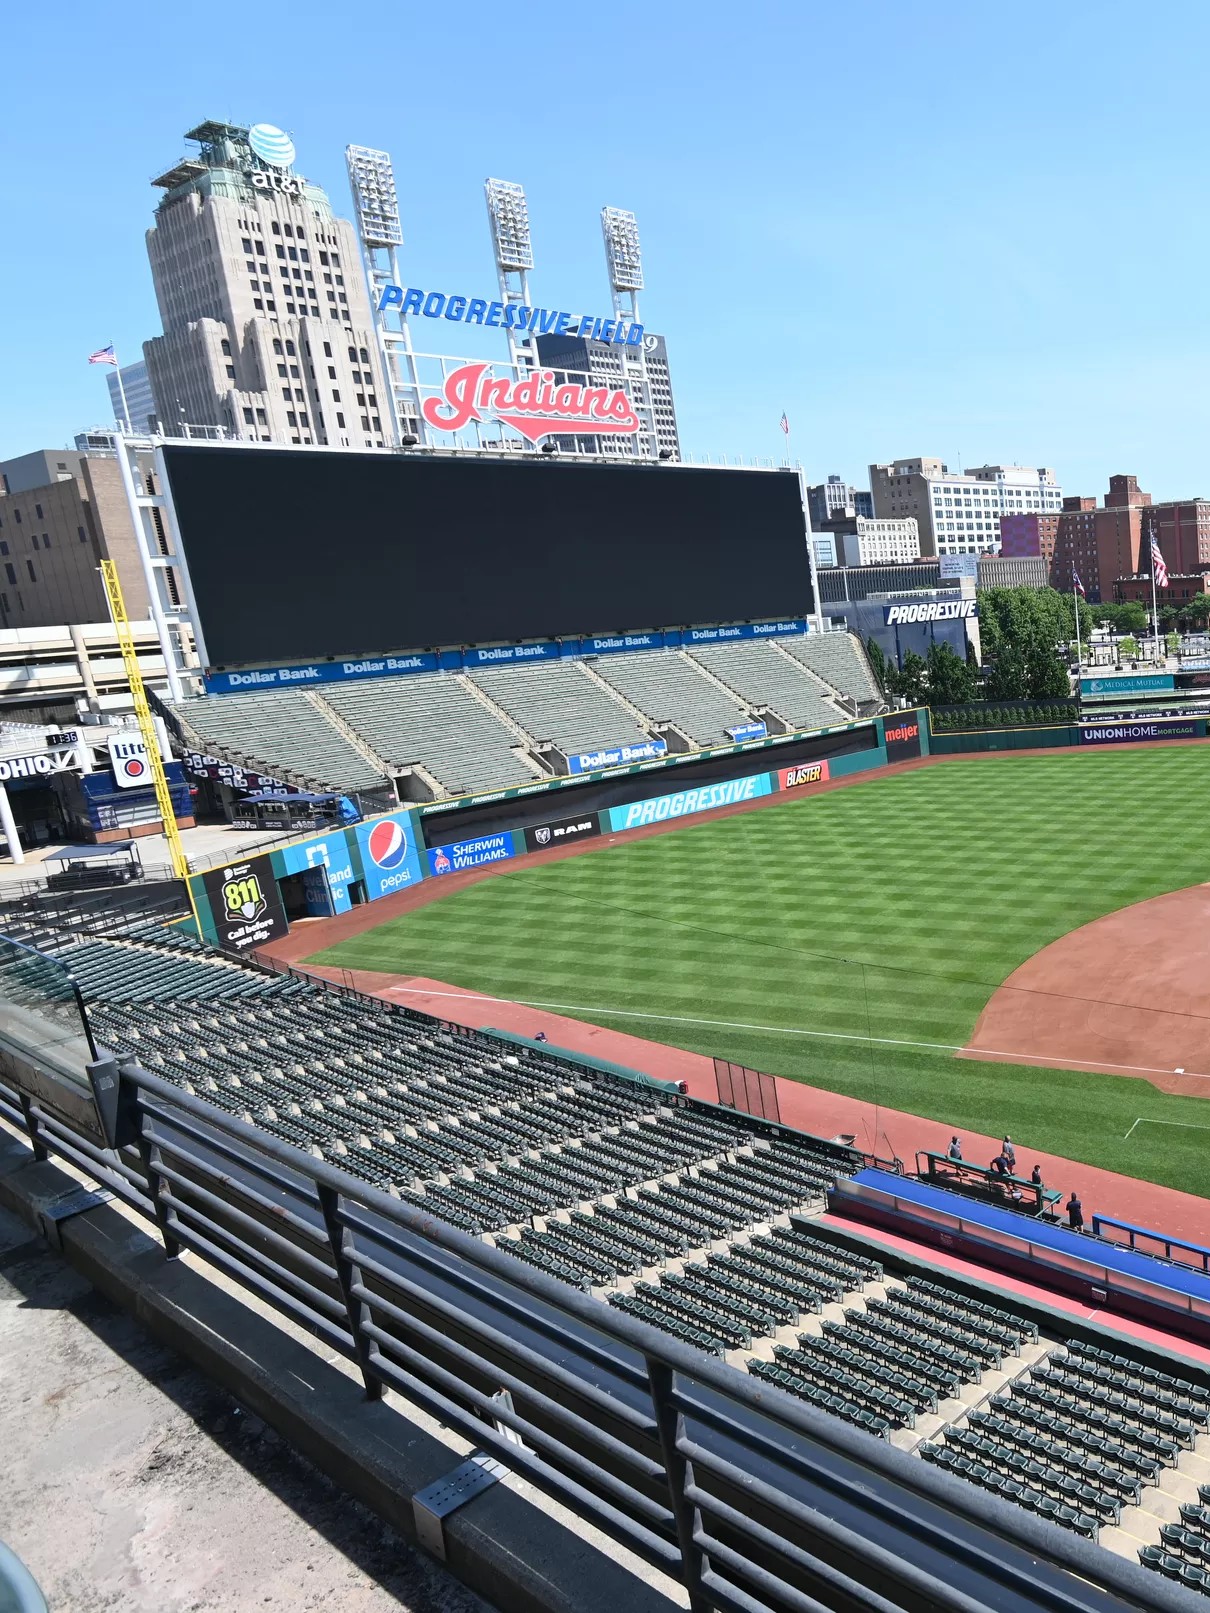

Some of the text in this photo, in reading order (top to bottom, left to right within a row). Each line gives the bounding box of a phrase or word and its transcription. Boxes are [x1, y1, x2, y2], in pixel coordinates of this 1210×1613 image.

[252, 167, 307, 195] at&t
[378, 284, 644, 346] PROGRESSIVE FIELD
[422, 363, 641, 444] Indians
[886, 600, 977, 626] PROGRESSIVE
[692, 630, 717, 640] Dollar
[753, 624, 776, 634] Dollar
[594, 638, 624, 650] Dollar
[478, 647, 515, 660] Dollar
[343, 662, 386, 675] Dollar
[228, 671, 276, 686] Dollar
[1104, 680, 1134, 688] MEDICAL
[52, 732, 77, 744] 11:36
[885, 724, 919, 742] meijer
[114, 744, 145, 759] Lite
[580, 750, 620, 768] Dollar
[0, 755, 50, 781] OHIO
[786, 765, 821, 788] BLASTER
[517, 784, 551, 794] PROGRESSIVE
[560, 775, 592, 786] PROGRESSIVE
[471, 792, 507, 804] PROGRESSIVE
[625, 777, 756, 828] PROGRESSIVE
[423, 801, 461, 814] PROGRESSIVE
[554, 821, 592, 837] RAM
[453, 836, 504, 857] SHERWIN
[380, 868, 411, 892] pepsi
[225, 877, 261, 910] 811
[228, 918, 274, 940] Call before
[235, 930, 270, 950] you dig.
